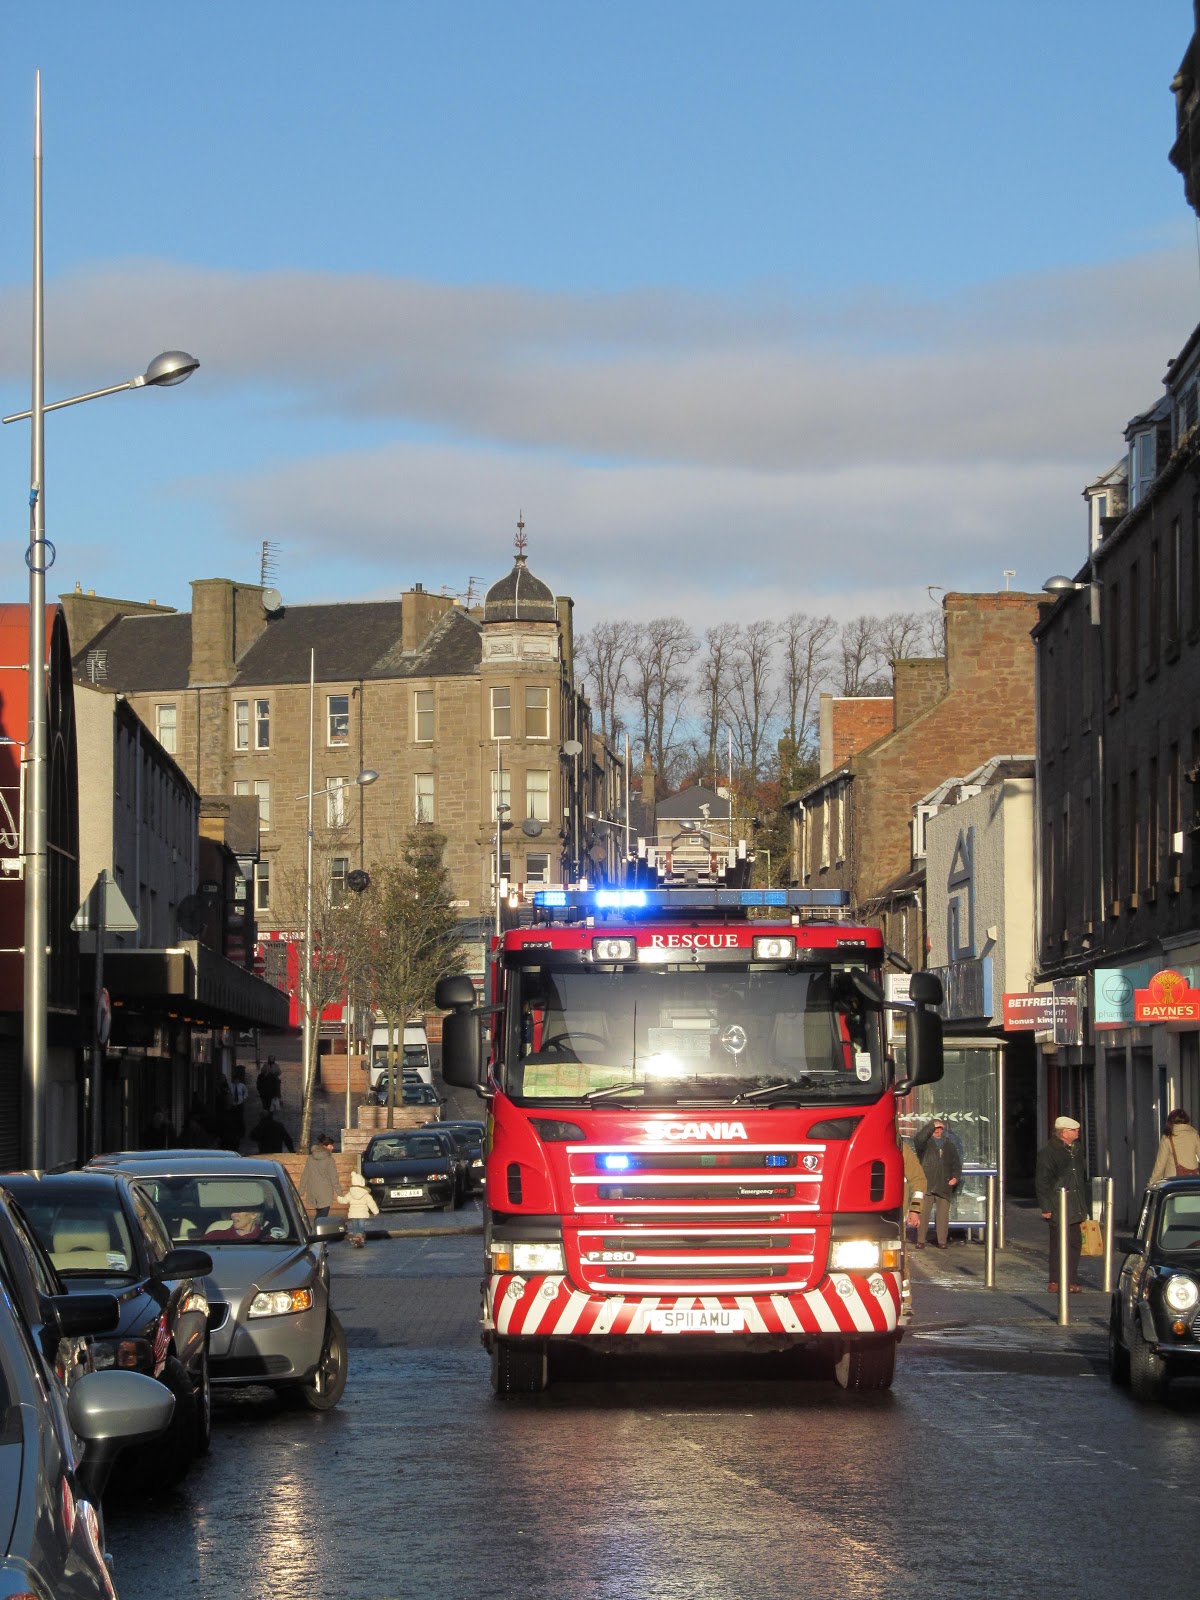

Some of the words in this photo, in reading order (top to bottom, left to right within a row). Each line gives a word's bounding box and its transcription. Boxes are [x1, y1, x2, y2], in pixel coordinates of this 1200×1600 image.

[651, 934, 739, 948] RESCUE
[1008, 996, 1053, 1007] BETFRED
[1098, 1010, 1134, 1020] pharmac
[1143, 1006, 1194, 1016] BAYNE'S
[1037, 1016, 1055, 1025] king
[645, 1121, 748, 1140] SCANIA
[589, 1252, 600, 1261] P
[602, 1251, 635, 1261] 280
[664, 1312, 694, 1327] SP11
[700, 1312, 730, 1327] AMU
